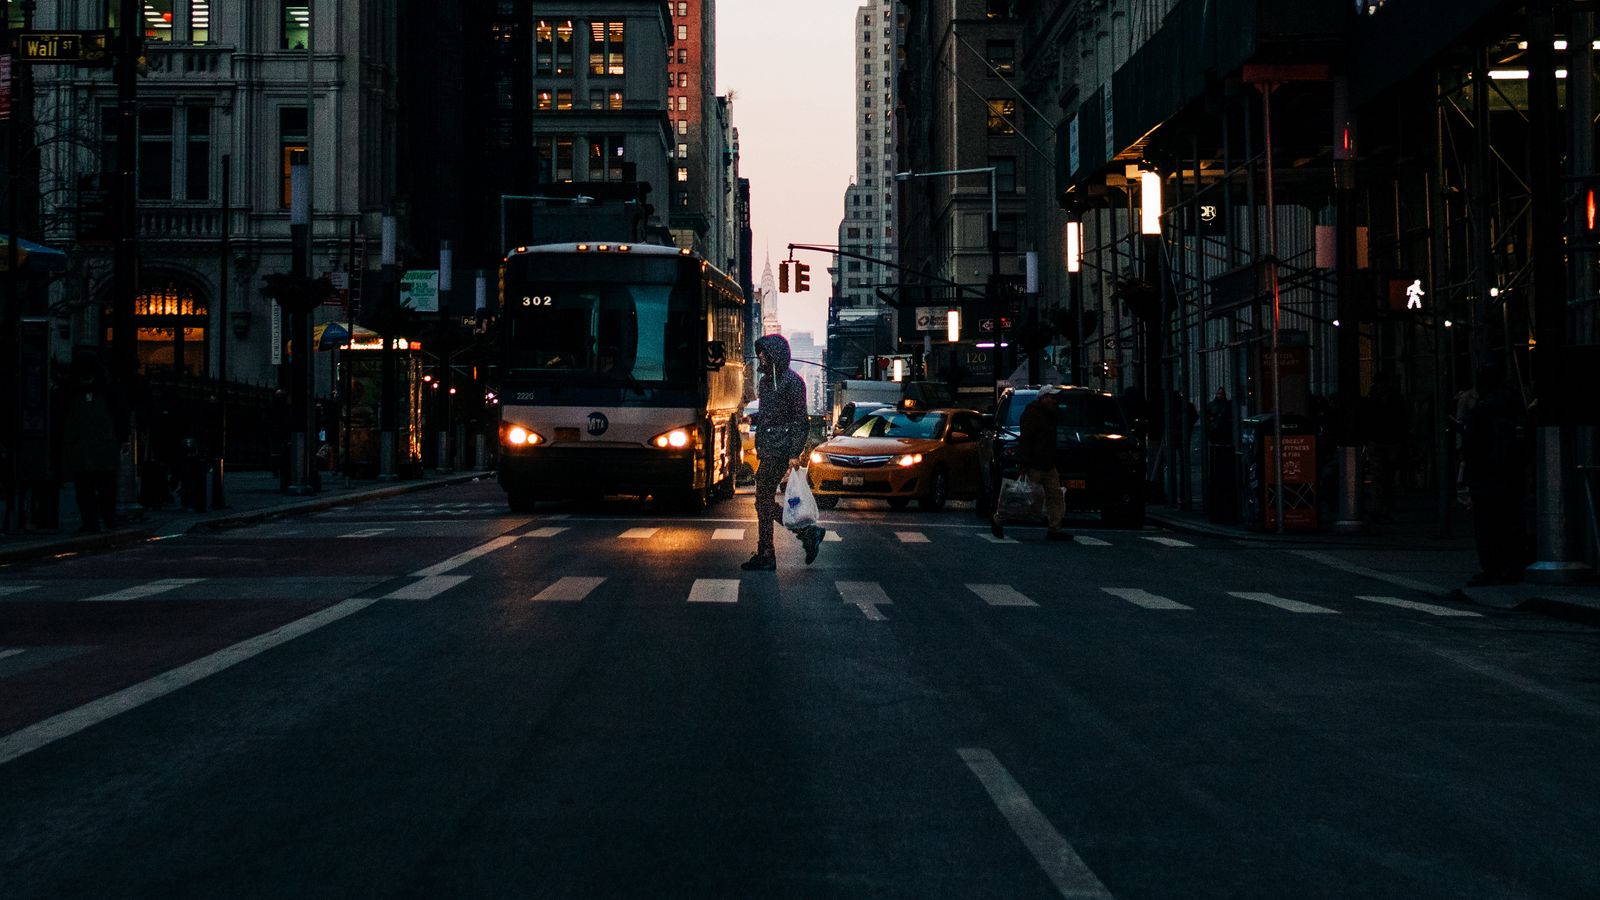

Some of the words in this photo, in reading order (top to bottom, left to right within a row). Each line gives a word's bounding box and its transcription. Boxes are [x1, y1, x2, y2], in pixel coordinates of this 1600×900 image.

[27, 41, 57, 56] Wall
[62, 41, 72, 49] ST
[522, 296, 552, 306] 302
[967, 351, 987, 363] 120
[517, 392, 535, 400] 2220
[588, 416, 606, 431] MTA
